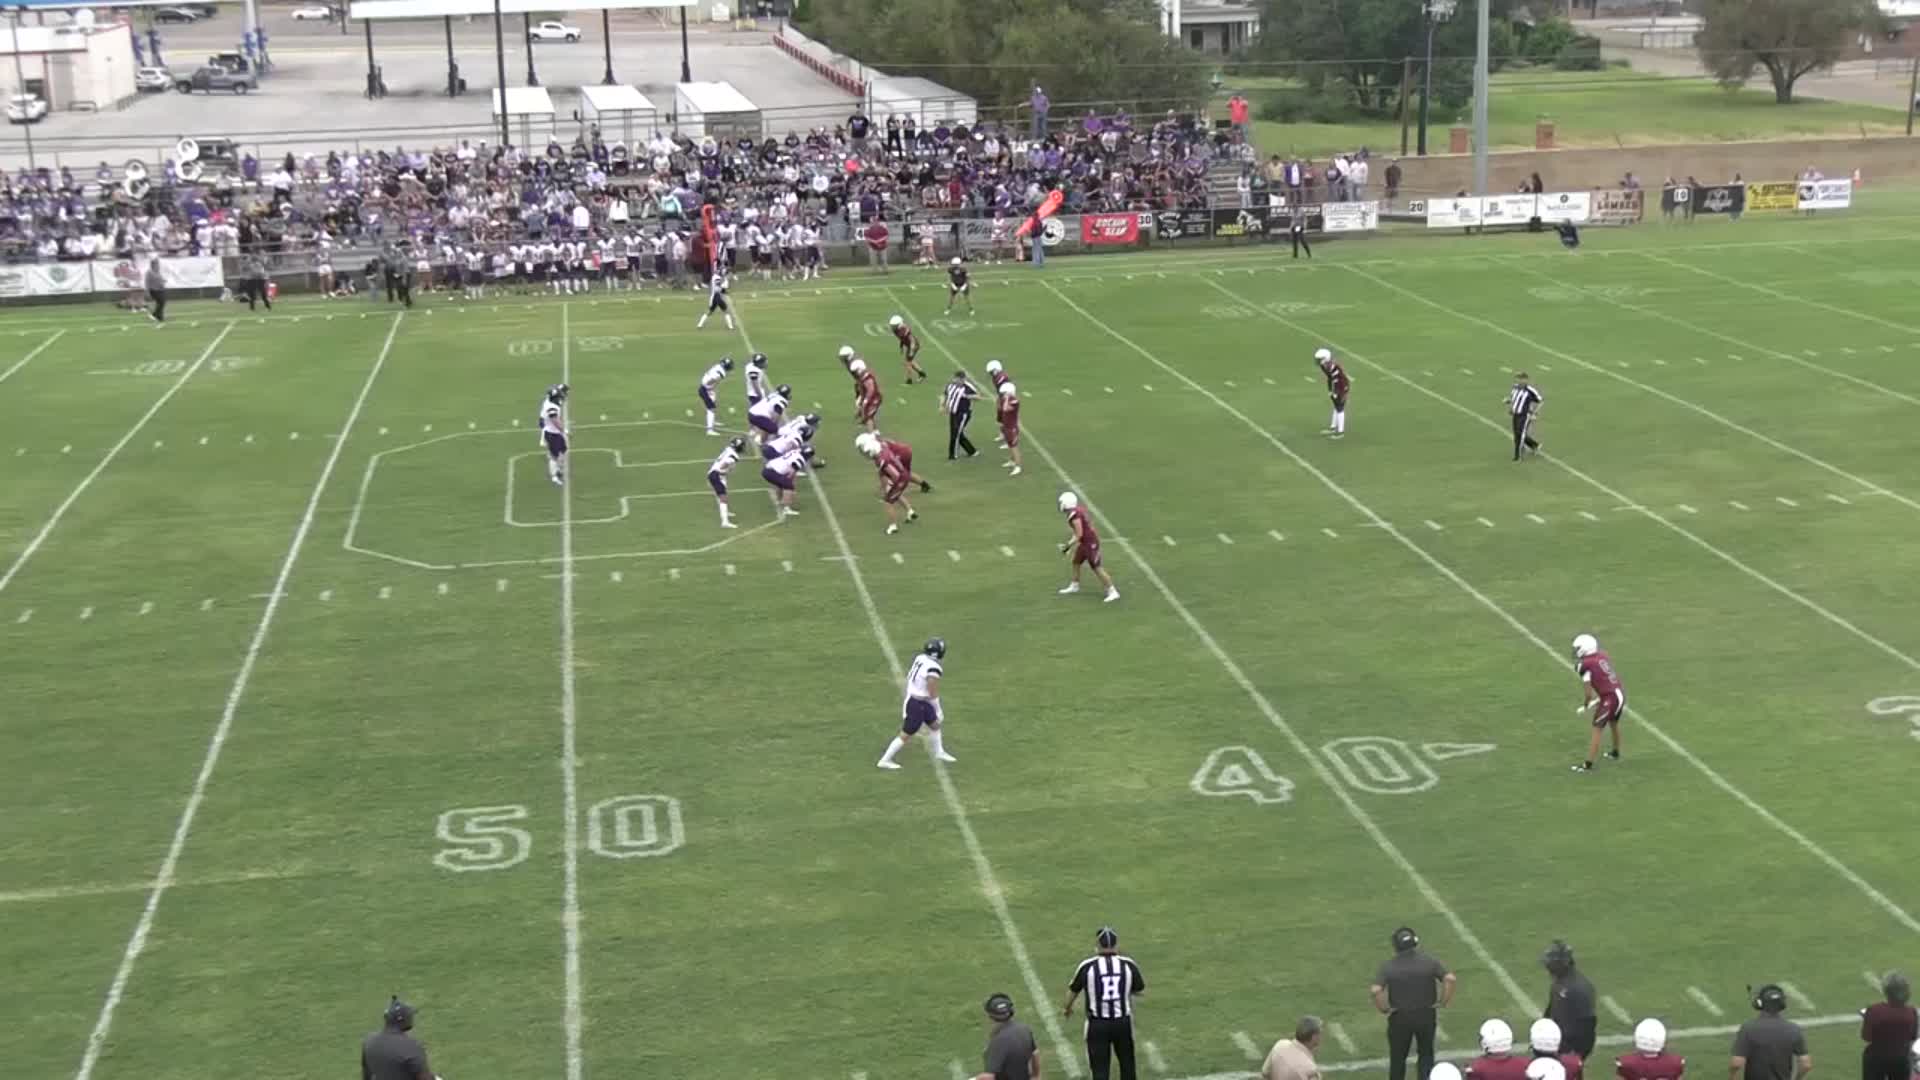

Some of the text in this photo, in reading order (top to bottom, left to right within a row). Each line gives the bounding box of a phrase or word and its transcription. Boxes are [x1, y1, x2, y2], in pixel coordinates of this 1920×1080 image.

[1138, 215, 1151, 225] 30
[1190, 735, 1439, 804] 40
[433, 794, 685, 872] 50
[1101, 975, 1122, 1001] H
